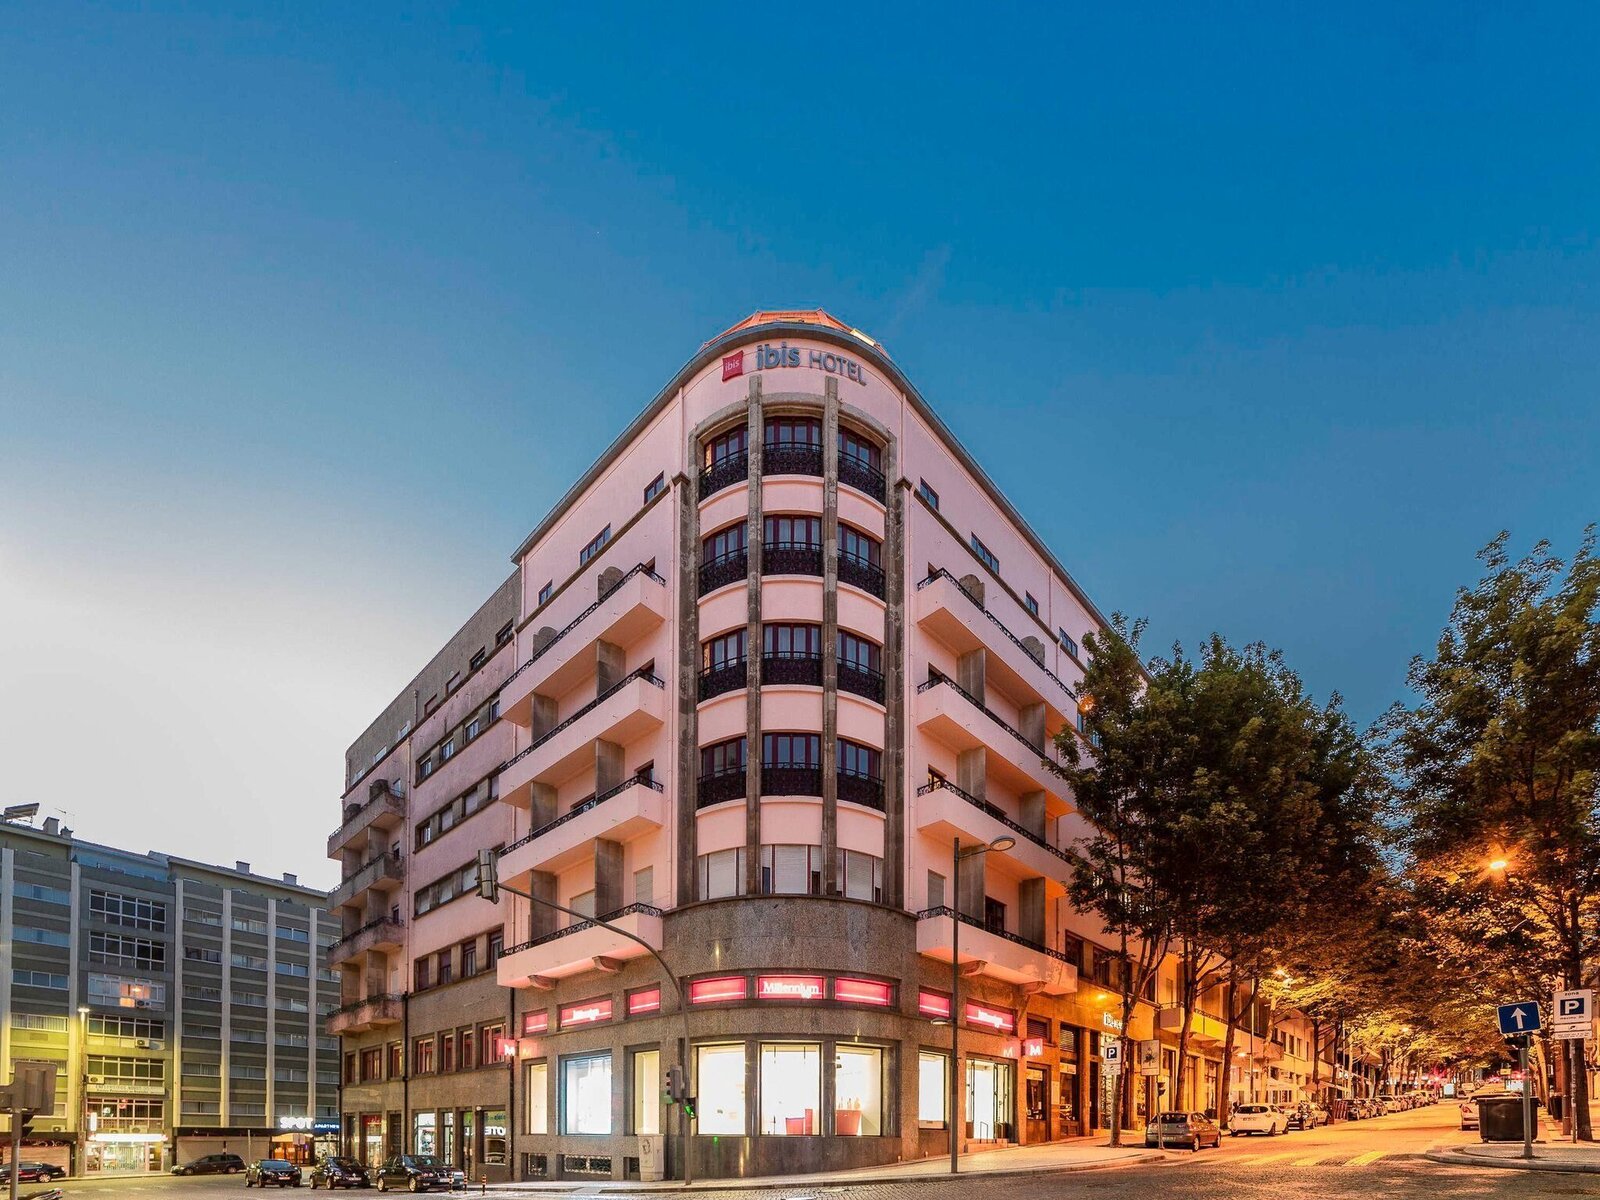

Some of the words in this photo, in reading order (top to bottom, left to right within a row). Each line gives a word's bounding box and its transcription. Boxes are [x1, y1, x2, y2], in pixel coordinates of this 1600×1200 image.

[725, 358, 740, 372] ibis
[756, 342, 800, 370] ibis
[809, 350, 867, 386] HOTEL
[763, 981, 820, 995] Millennium
[1564, 1000, 1580, 1014] P
[1030, 1044, 1041, 1056] M
[1108, 1048, 1116, 1058] P
[280, 1116, 313, 1129] SPOT
